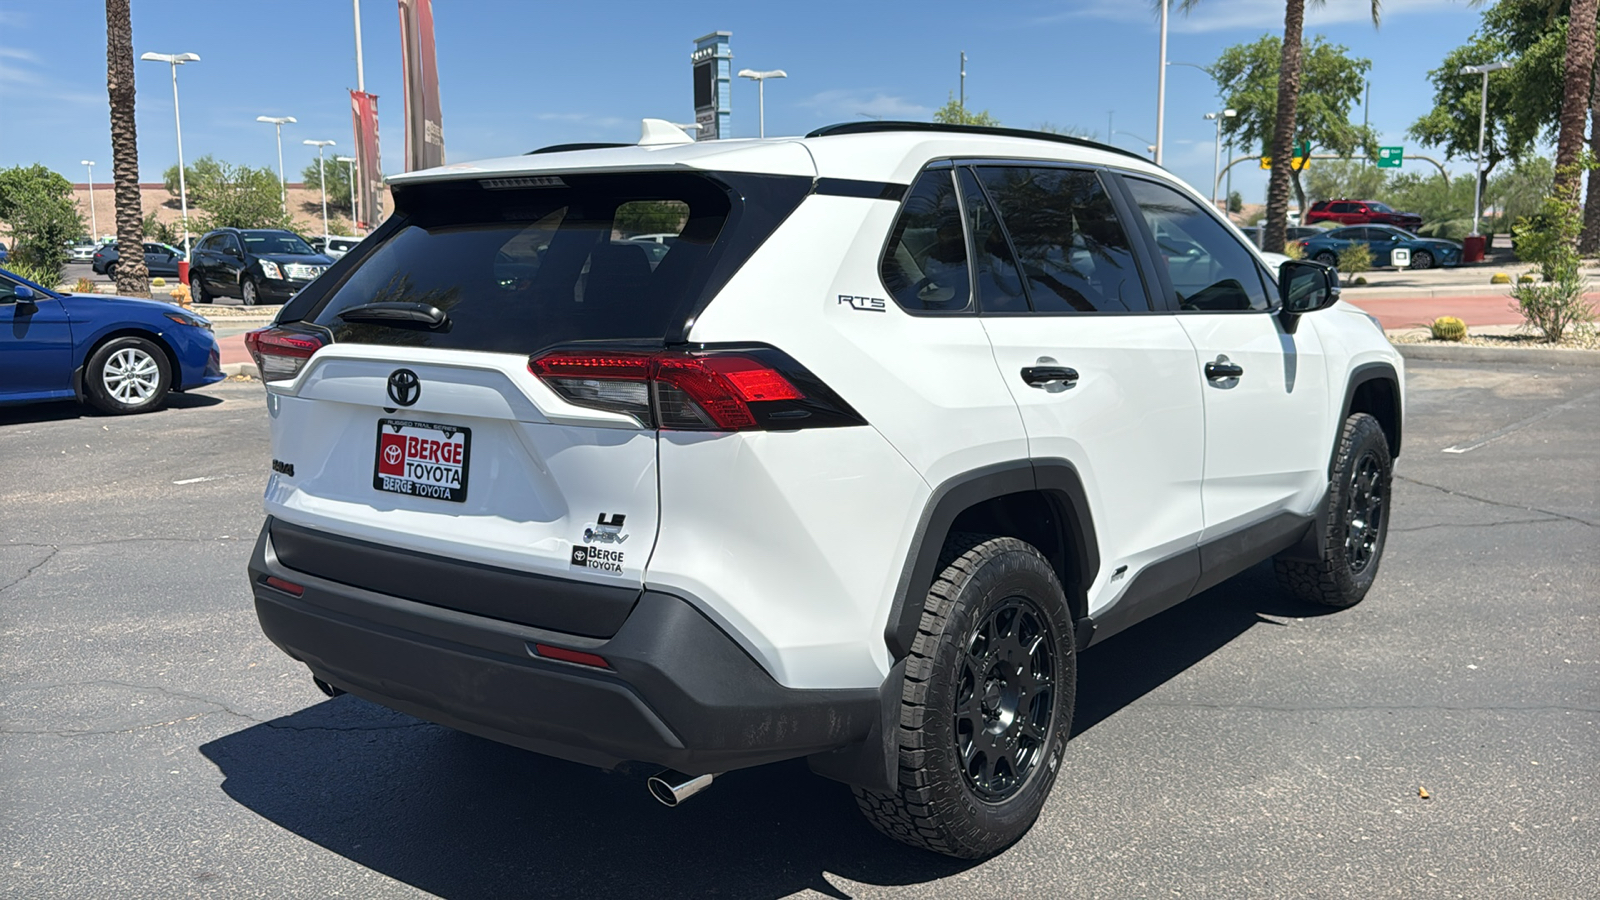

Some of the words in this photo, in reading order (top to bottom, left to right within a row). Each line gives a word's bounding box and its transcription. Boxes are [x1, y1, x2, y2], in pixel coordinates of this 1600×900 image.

[838, 295, 886, 313] RTS
[407, 436, 463, 464] BERGE
[406, 463, 461, 485] TOYOTA
[383, 477, 413, 493] BERGE
[415, 483, 451, 499] TOYOTA
[588, 559, 622, 572] TOYOTA
